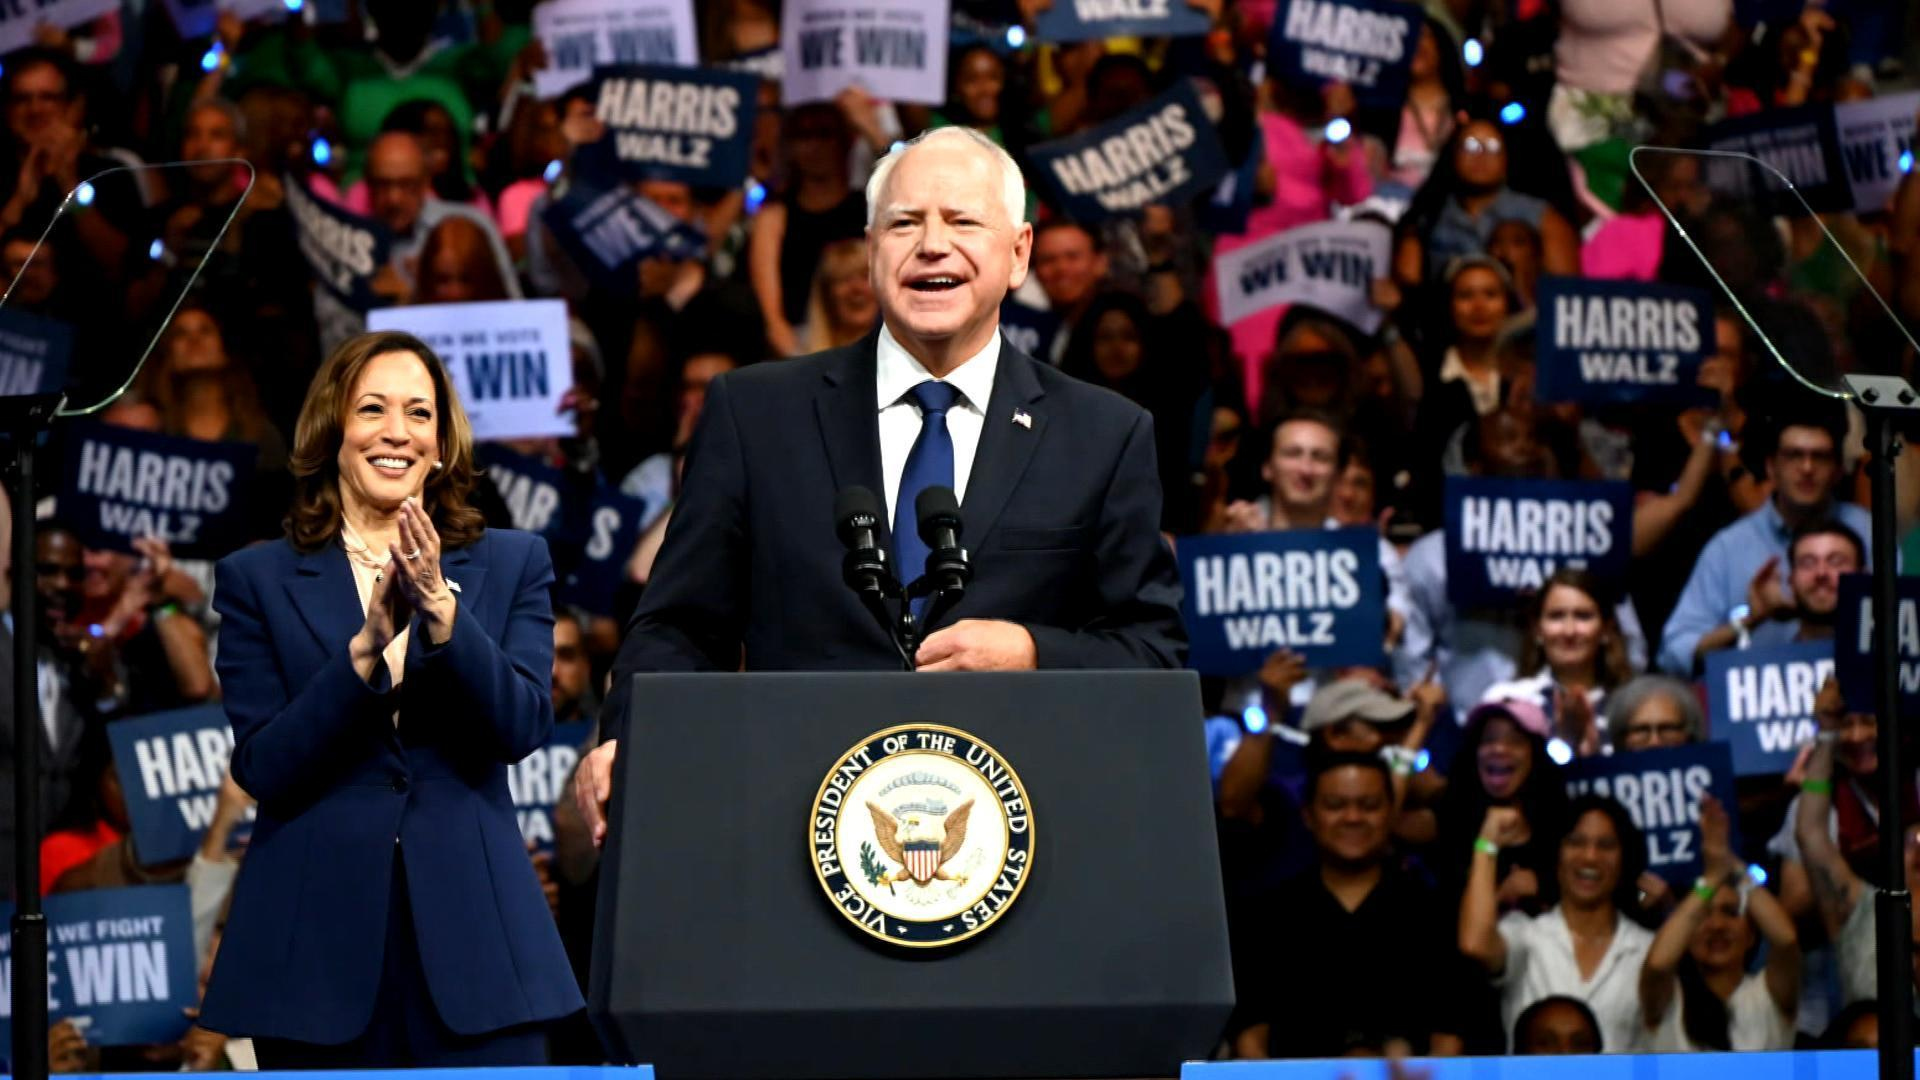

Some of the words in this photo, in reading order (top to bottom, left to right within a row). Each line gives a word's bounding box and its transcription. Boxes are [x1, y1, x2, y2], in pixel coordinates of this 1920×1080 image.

[800, 26, 842, 69] WE
[854, 27, 928, 69] WIN
[1284, 0, 1409, 62] HARRIS
[1301, 49, 1380, 87] WALZ
[599, 77, 740, 139] HARRIS
[615, 132, 713, 168] WALZ
[1052, 103, 1196, 194] HARRIS
[1097, 154, 1191, 211] WALZ
[1301, 248, 1375, 297] WIN
[1555, 295, 1701, 352] HARRIS
[465, 350, 549, 402] WIN
[1579, 352, 1679, 384] WALZ
[77, 439, 235, 513] HARRIS
[99, 500, 201, 543] WALZ
[1462, 496, 1614, 557] HARRIS
[1193, 548, 1361, 615] HARRIS
[1224, 612, 1335, 650] WALZ
[883, 735, 908, 754] OF
[917, 733, 956, 753] THE
[816, 746, 873, 877] PRESIDENT
[965, 745, 1028, 834] UNITED
[836, 882, 886, 934] VICE
[961, 848, 1027, 931] STATES
[55, 922, 91, 944] WE
[96, 915, 164, 939] FIGHT
[65, 940, 169, 1006] WIN
